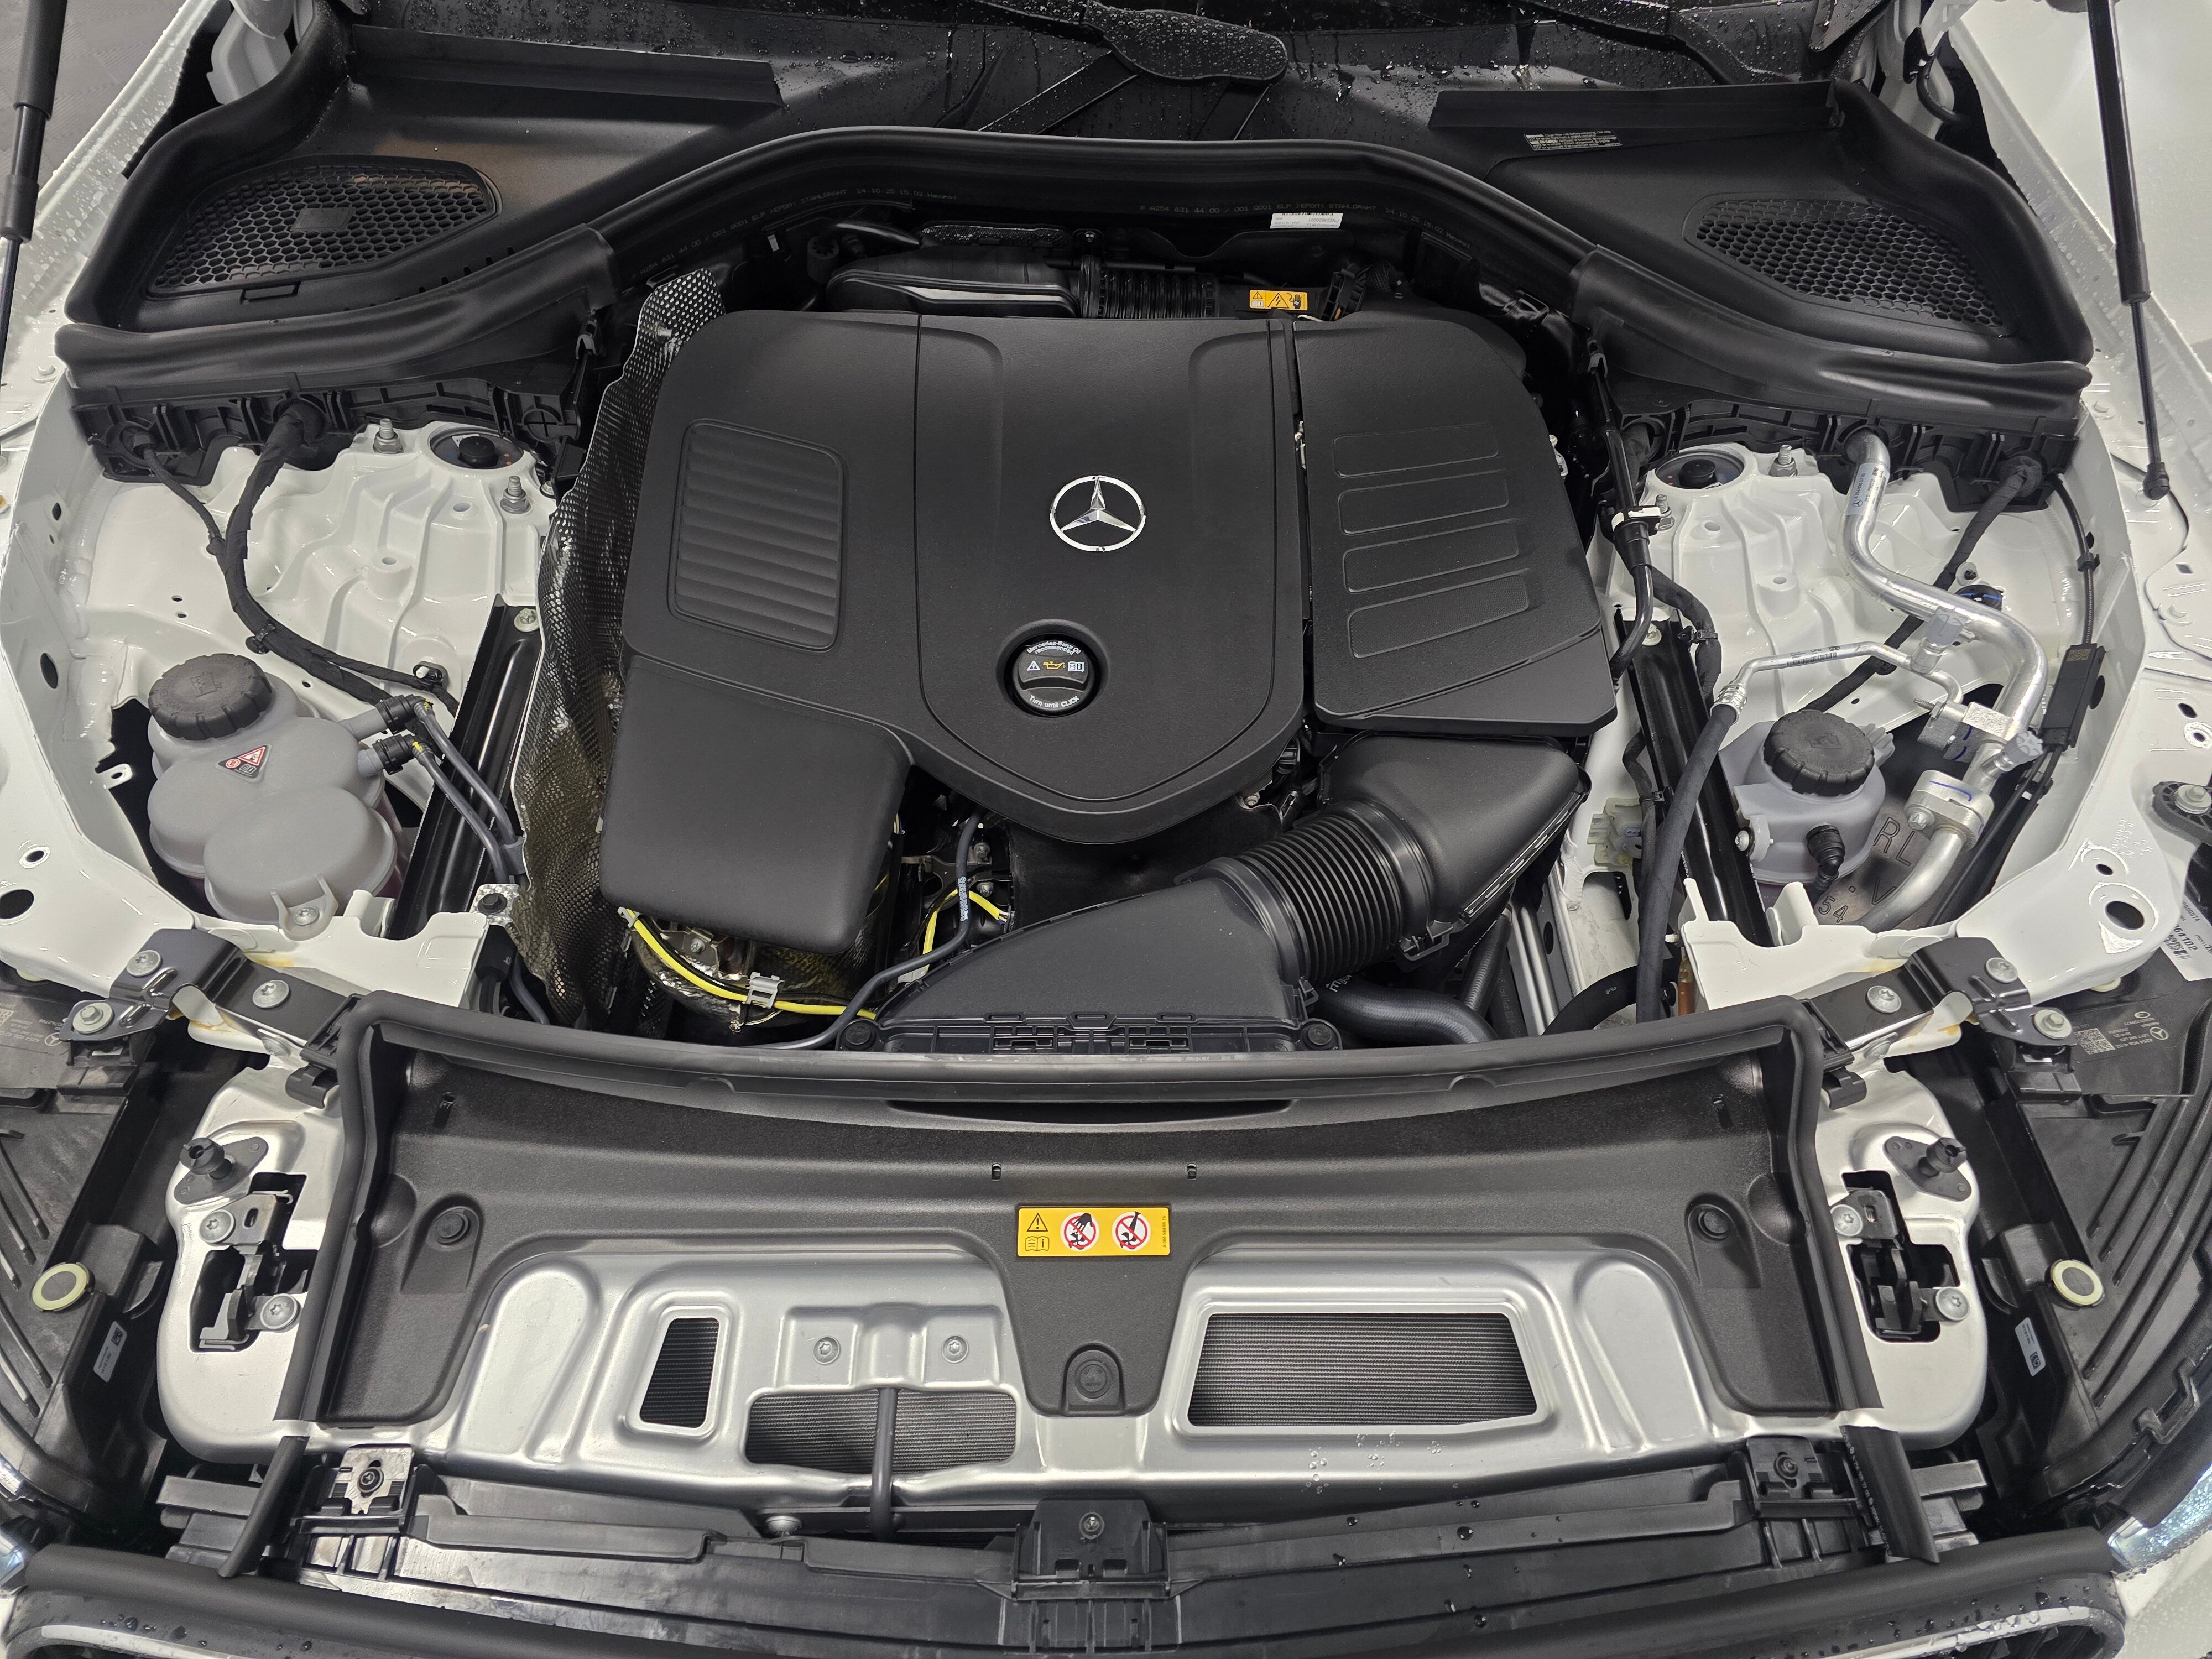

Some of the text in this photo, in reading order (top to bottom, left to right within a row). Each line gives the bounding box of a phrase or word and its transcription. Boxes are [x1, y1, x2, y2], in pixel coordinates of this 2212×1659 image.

[1026, 640, 1073, 654] Mercedes-Benz
[1034, 645, 1074, 655] recommended
[1029, 695, 1043, 706] Turn
[1061, 695, 1080, 707] CLICK
[1872, 817, 1916, 867] RL
